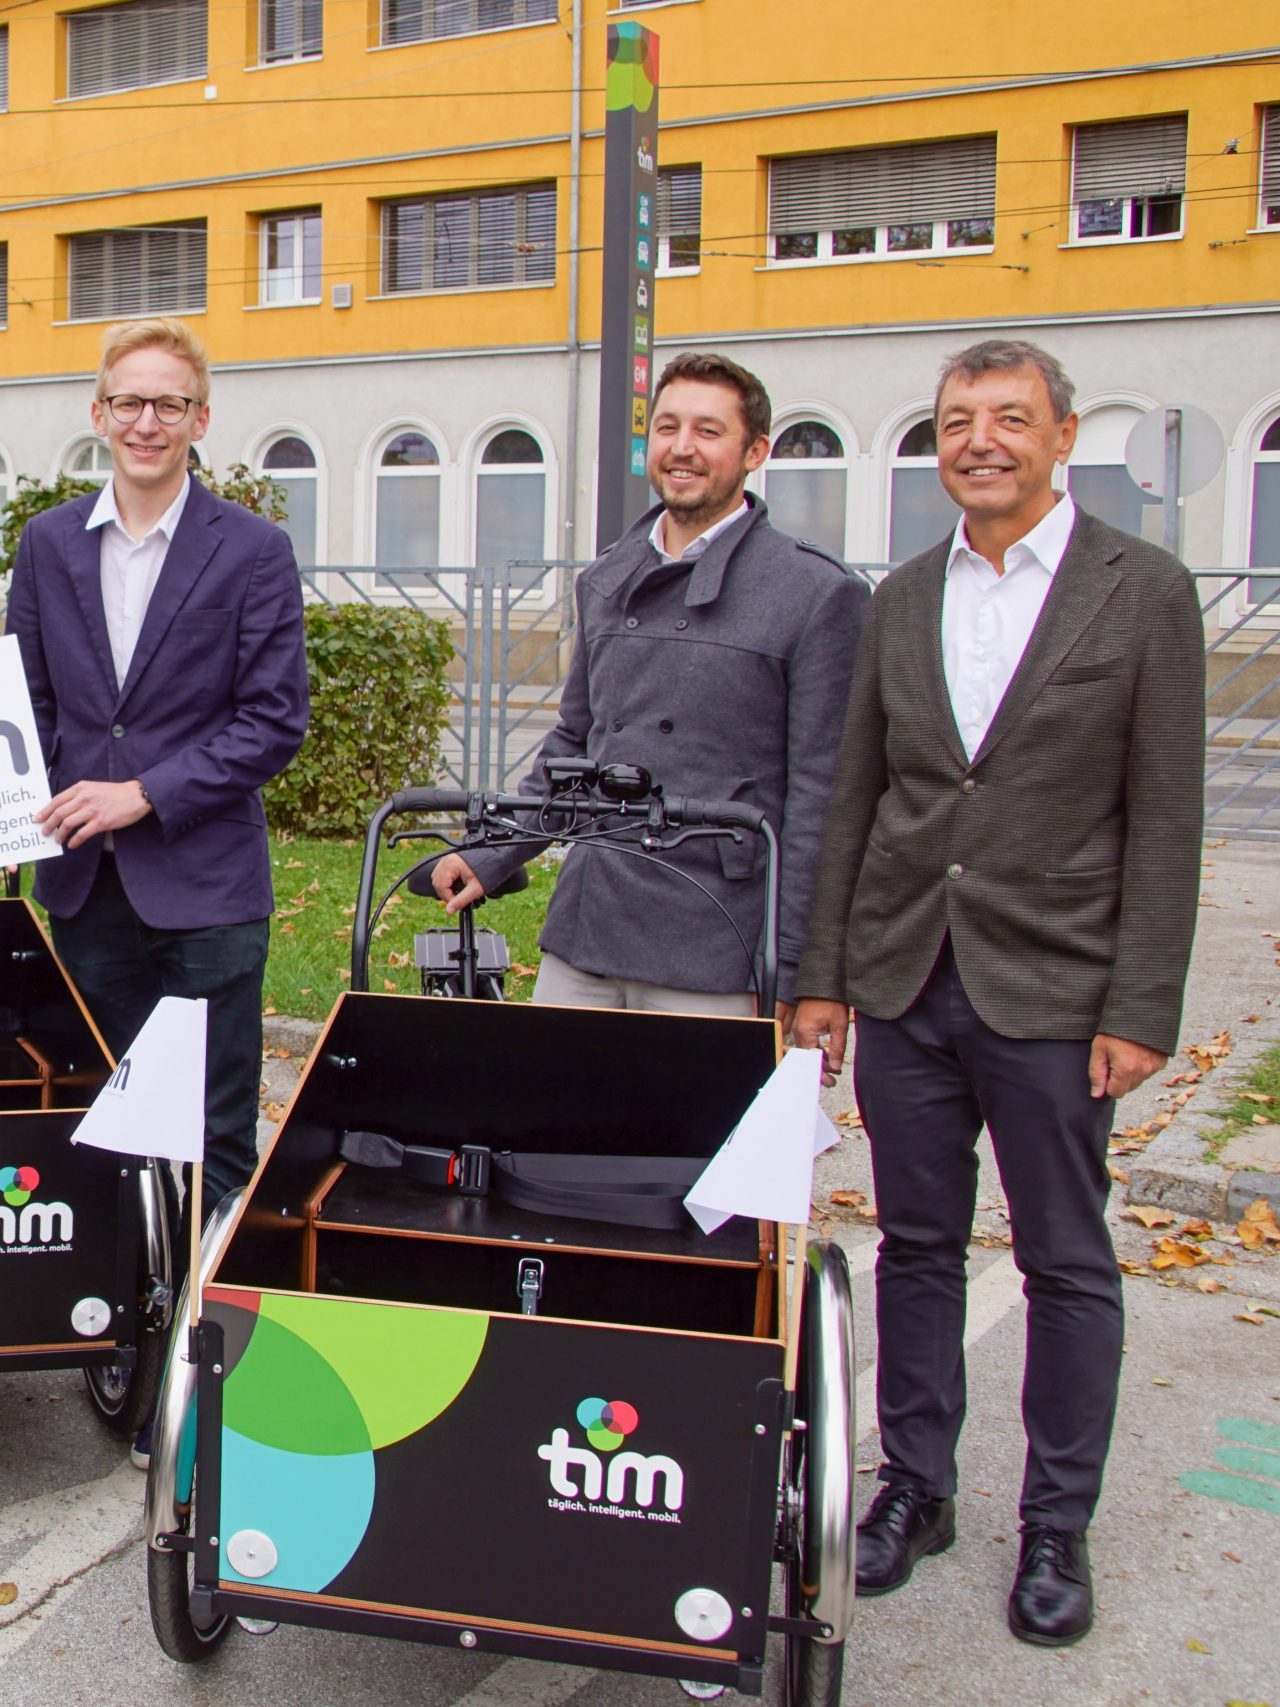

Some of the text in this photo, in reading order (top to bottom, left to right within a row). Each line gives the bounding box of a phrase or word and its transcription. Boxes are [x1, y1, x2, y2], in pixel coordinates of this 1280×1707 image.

[7, 1245, 48, 1255] intelligent.
[49, 1243, 73, 1252] mobil.
[538, 1427, 684, 1511] tim
[548, 1498, 681, 1524] täglich. intelligent. mobil.
